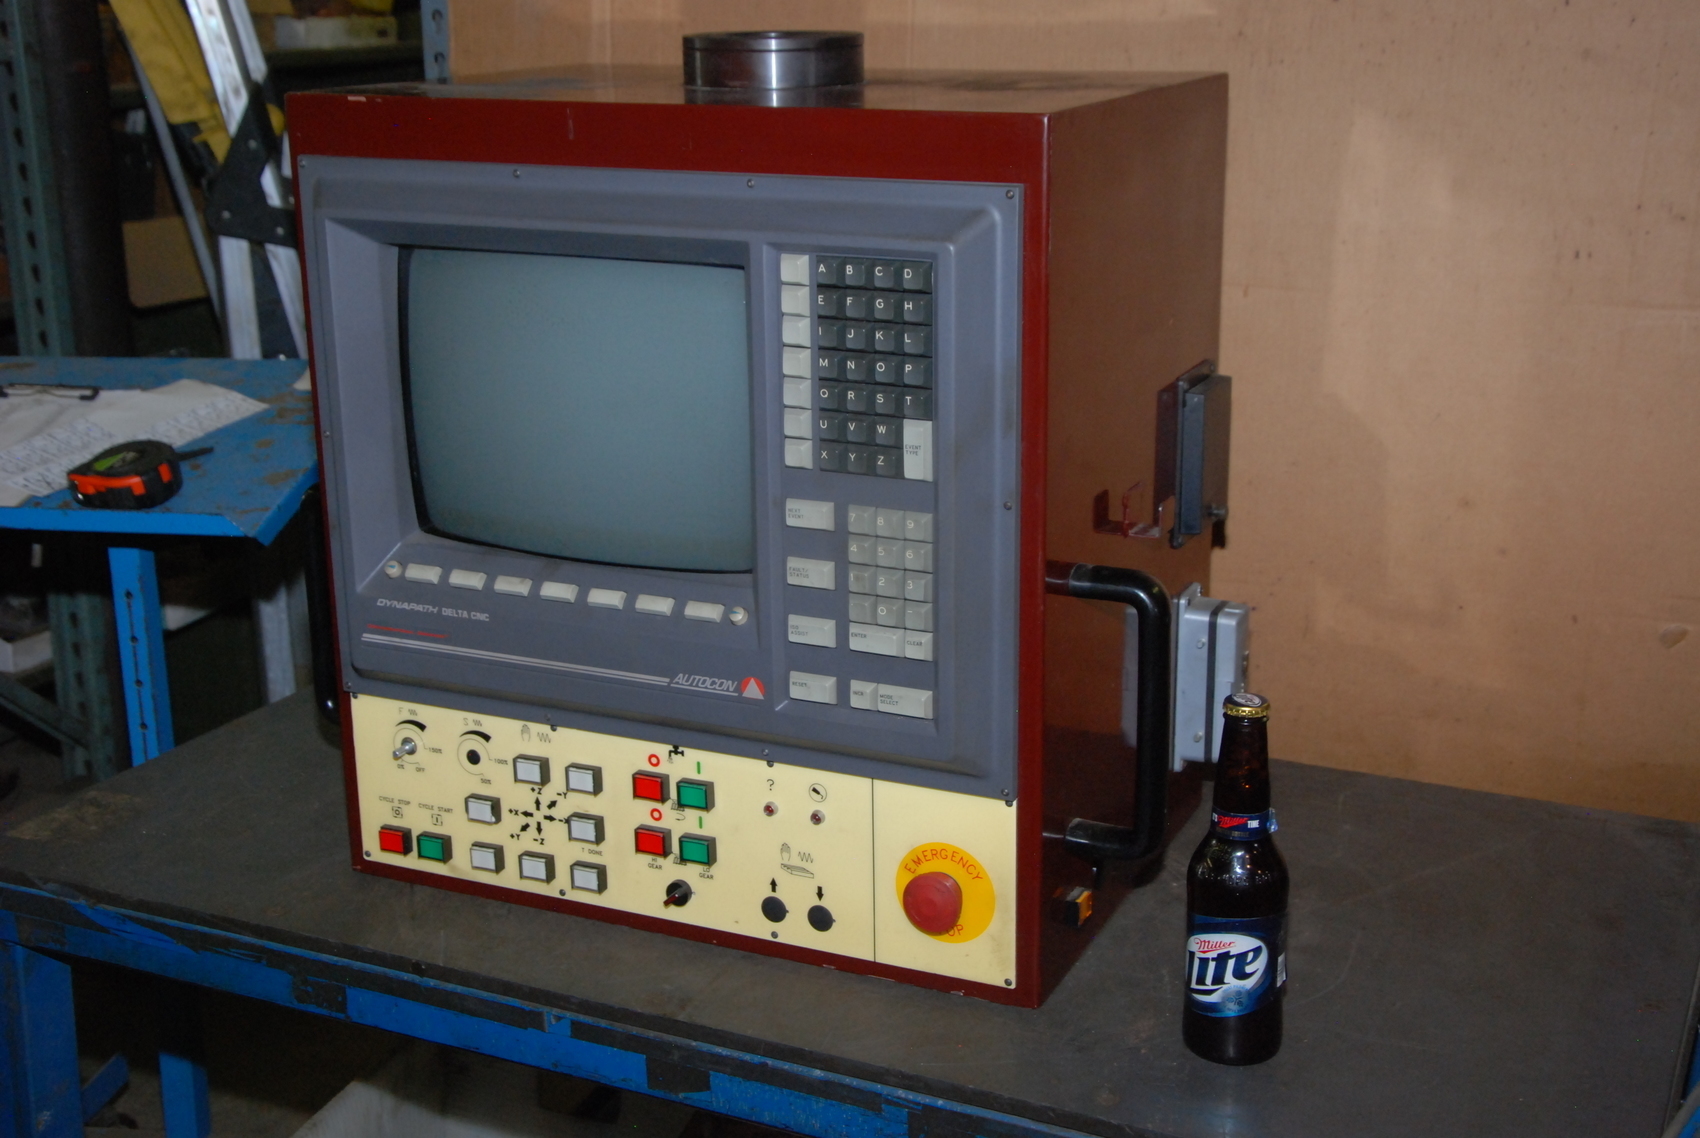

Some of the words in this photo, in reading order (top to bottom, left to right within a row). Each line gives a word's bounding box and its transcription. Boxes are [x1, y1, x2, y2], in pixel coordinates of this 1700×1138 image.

[818, 264, 826, 272] A
[846, 265, 853, 274] B
[875, 267, 883, 276] C
[904, 269, 912, 278] D
[818, 295, 824, 304] E
[847, 297, 853, 306] F
[876, 299, 884, 308] G
[904, 302, 912, 310] H
[847, 329, 854, 338] J
[876, 331, 883, 340] K
[904, 333, 911, 342] L
[820, 358, 828, 367] M
[847, 361, 855, 369] N
[877, 362, 885, 371] O
[905, 364, 912, 373] P
[820, 389, 828, 398] Q
[848, 391, 855, 400] R
[877, 394, 884, 403] S
[905, 397, 911, 405] T
[820, 420, 827, 428] U
[877, 425, 886, 434] W
[821, 451, 828, 459] X
[849, 453, 856, 461] Y
[878, 456, 884, 465] Z
[850, 513, 856, 521] 7
[877, 517, 884, 526] 8
[906, 520, 914, 528] 9
[878, 547, 884, 556] 5
[906, 550, 913, 558] 6
[879, 578, 885, 586] 2
[907, 581, 913, 589] 3
[376, 598, 438, 614] DYNAPATH
[442, 608, 468, 618] DELTA
[470, 612, 490, 621] CNC
[673, 673, 738, 692] AUTOCON
[904, 848, 983, 880] EMERGENCY
[1194, 938, 1236, 951] Miller
[1187, 945, 1263, 996] Lite
